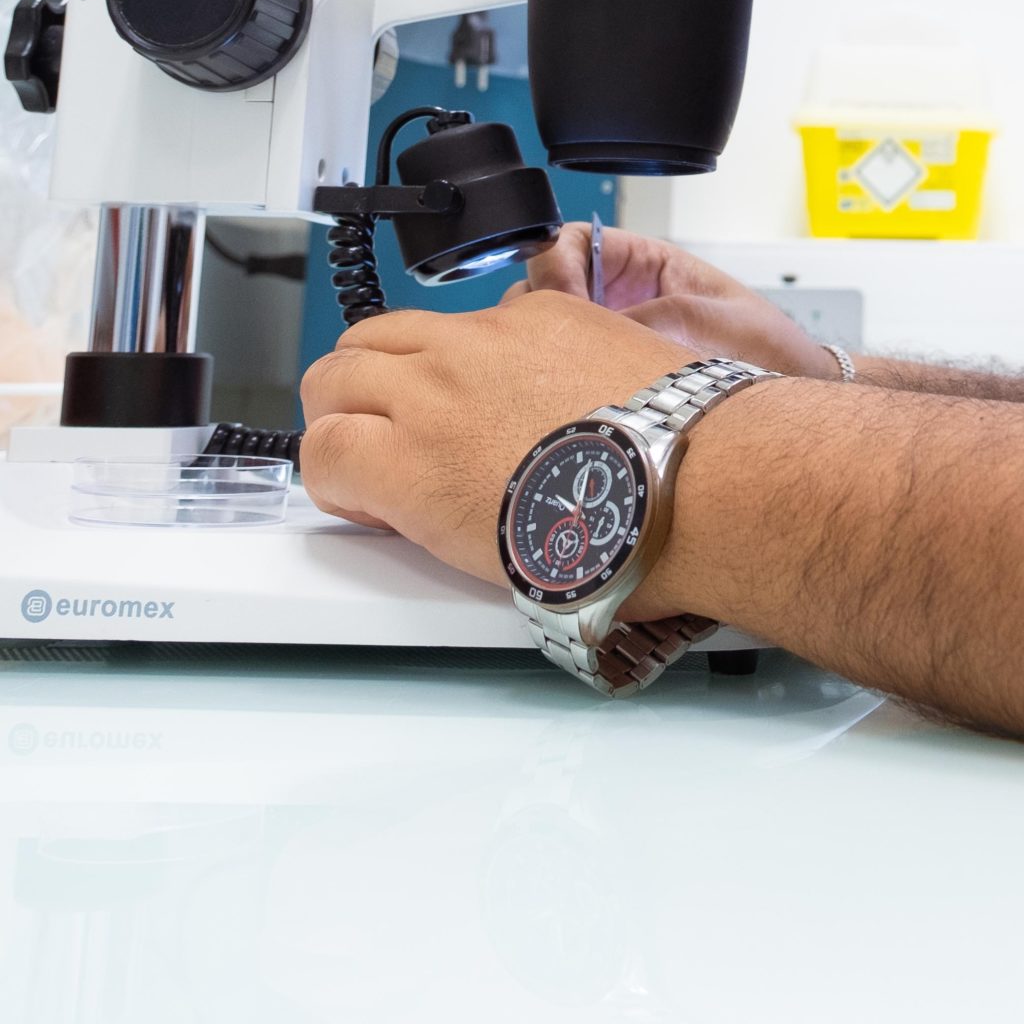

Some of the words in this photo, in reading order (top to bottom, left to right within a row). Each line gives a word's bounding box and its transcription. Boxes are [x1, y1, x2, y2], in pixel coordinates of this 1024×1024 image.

[598, 424, 615, 436] 30
[626, 447, 637, 459] 35
[507, 481, 517, 494] 15
[637, 484, 645, 498] 40
[545, 496, 565, 511] Quartz
[626, 526, 640, 546] 45
[601, 567, 613, 580] 50
[529, 587, 543, 601] 60
[565, 590, 577, 600] 55
[56, 598, 176, 619] euromex
